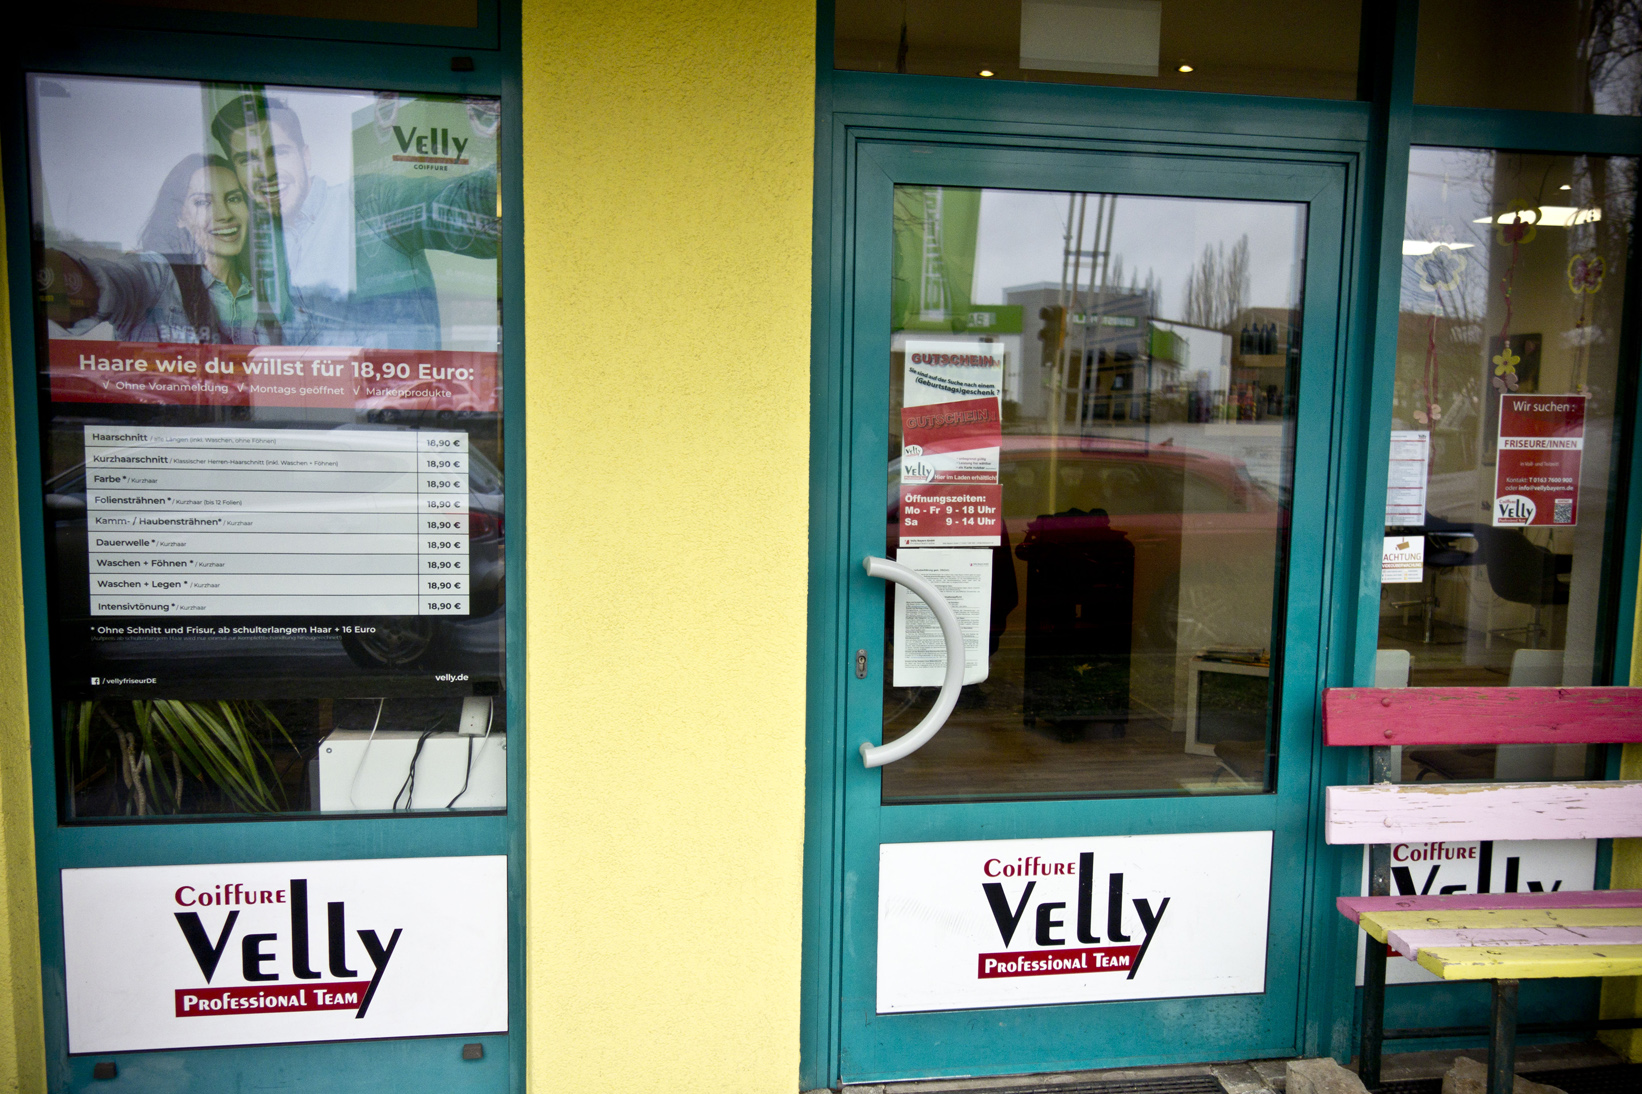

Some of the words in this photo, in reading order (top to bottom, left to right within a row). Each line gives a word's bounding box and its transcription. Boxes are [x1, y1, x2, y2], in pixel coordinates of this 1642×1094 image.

[392, 126, 468, 164] Velly
[911, 353, 996, 367] GUTSCHEIN
[79, 354, 148, 372] Haare
[156, 355, 198, 373] wie
[204, 357, 234, 374] du
[242, 358, 304, 376] willst
[312, 360, 344, 377] für
[352, 362, 410, 381] 18,90
[418, 364, 474, 380] Euro:
[116, 382, 146, 391] Ohne
[148, 382, 228, 394] Voranmeldung
[250, 385, 296, 396] Montags
[300, 386, 344, 397] geöffnet
[916, 376, 995, 395] (Geburtstags)geschenk
[366, 387, 452, 398] Markenprodukte
[1513, 401, 1531, 411] Wir
[1533, 401, 1569, 412] suchen
[906, 409, 988, 429] GUTSCHEIN
[92, 433, 148, 441] Haarschnitt
[1504, 440, 1577, 448] FRISEURE/INNEN
[93, 455, 168, 464] Kurzhaarschnitt
[905, 462, 932, 481] Velly
[94, 496, 165, 504] Foliensträhnen
[905, 493, 986, 504] Öffnungszeiten:
[905, 506, 920, 514] Mo
[930, 506, 940, 514] Fr
[946, 506, 952, 514] 9
[977, 506, 996, 514] Uhr
[1499, 499, 1533, 525] Velly
[95, 517, 130, 525] Kamm-
[904, 518, 918, 526] Sa
[152, 580, 181, 590] Legen
[98, 603, 169, 612] Intensivtönung
[186, 626, 216, 635] Frisur,
[232, 626, 307, 635] schulterlangem
[435, 673, 469, 682] velly.de
[982, 852, 1171, 980] Velly
[173, 879, 403, 1019] Velly
